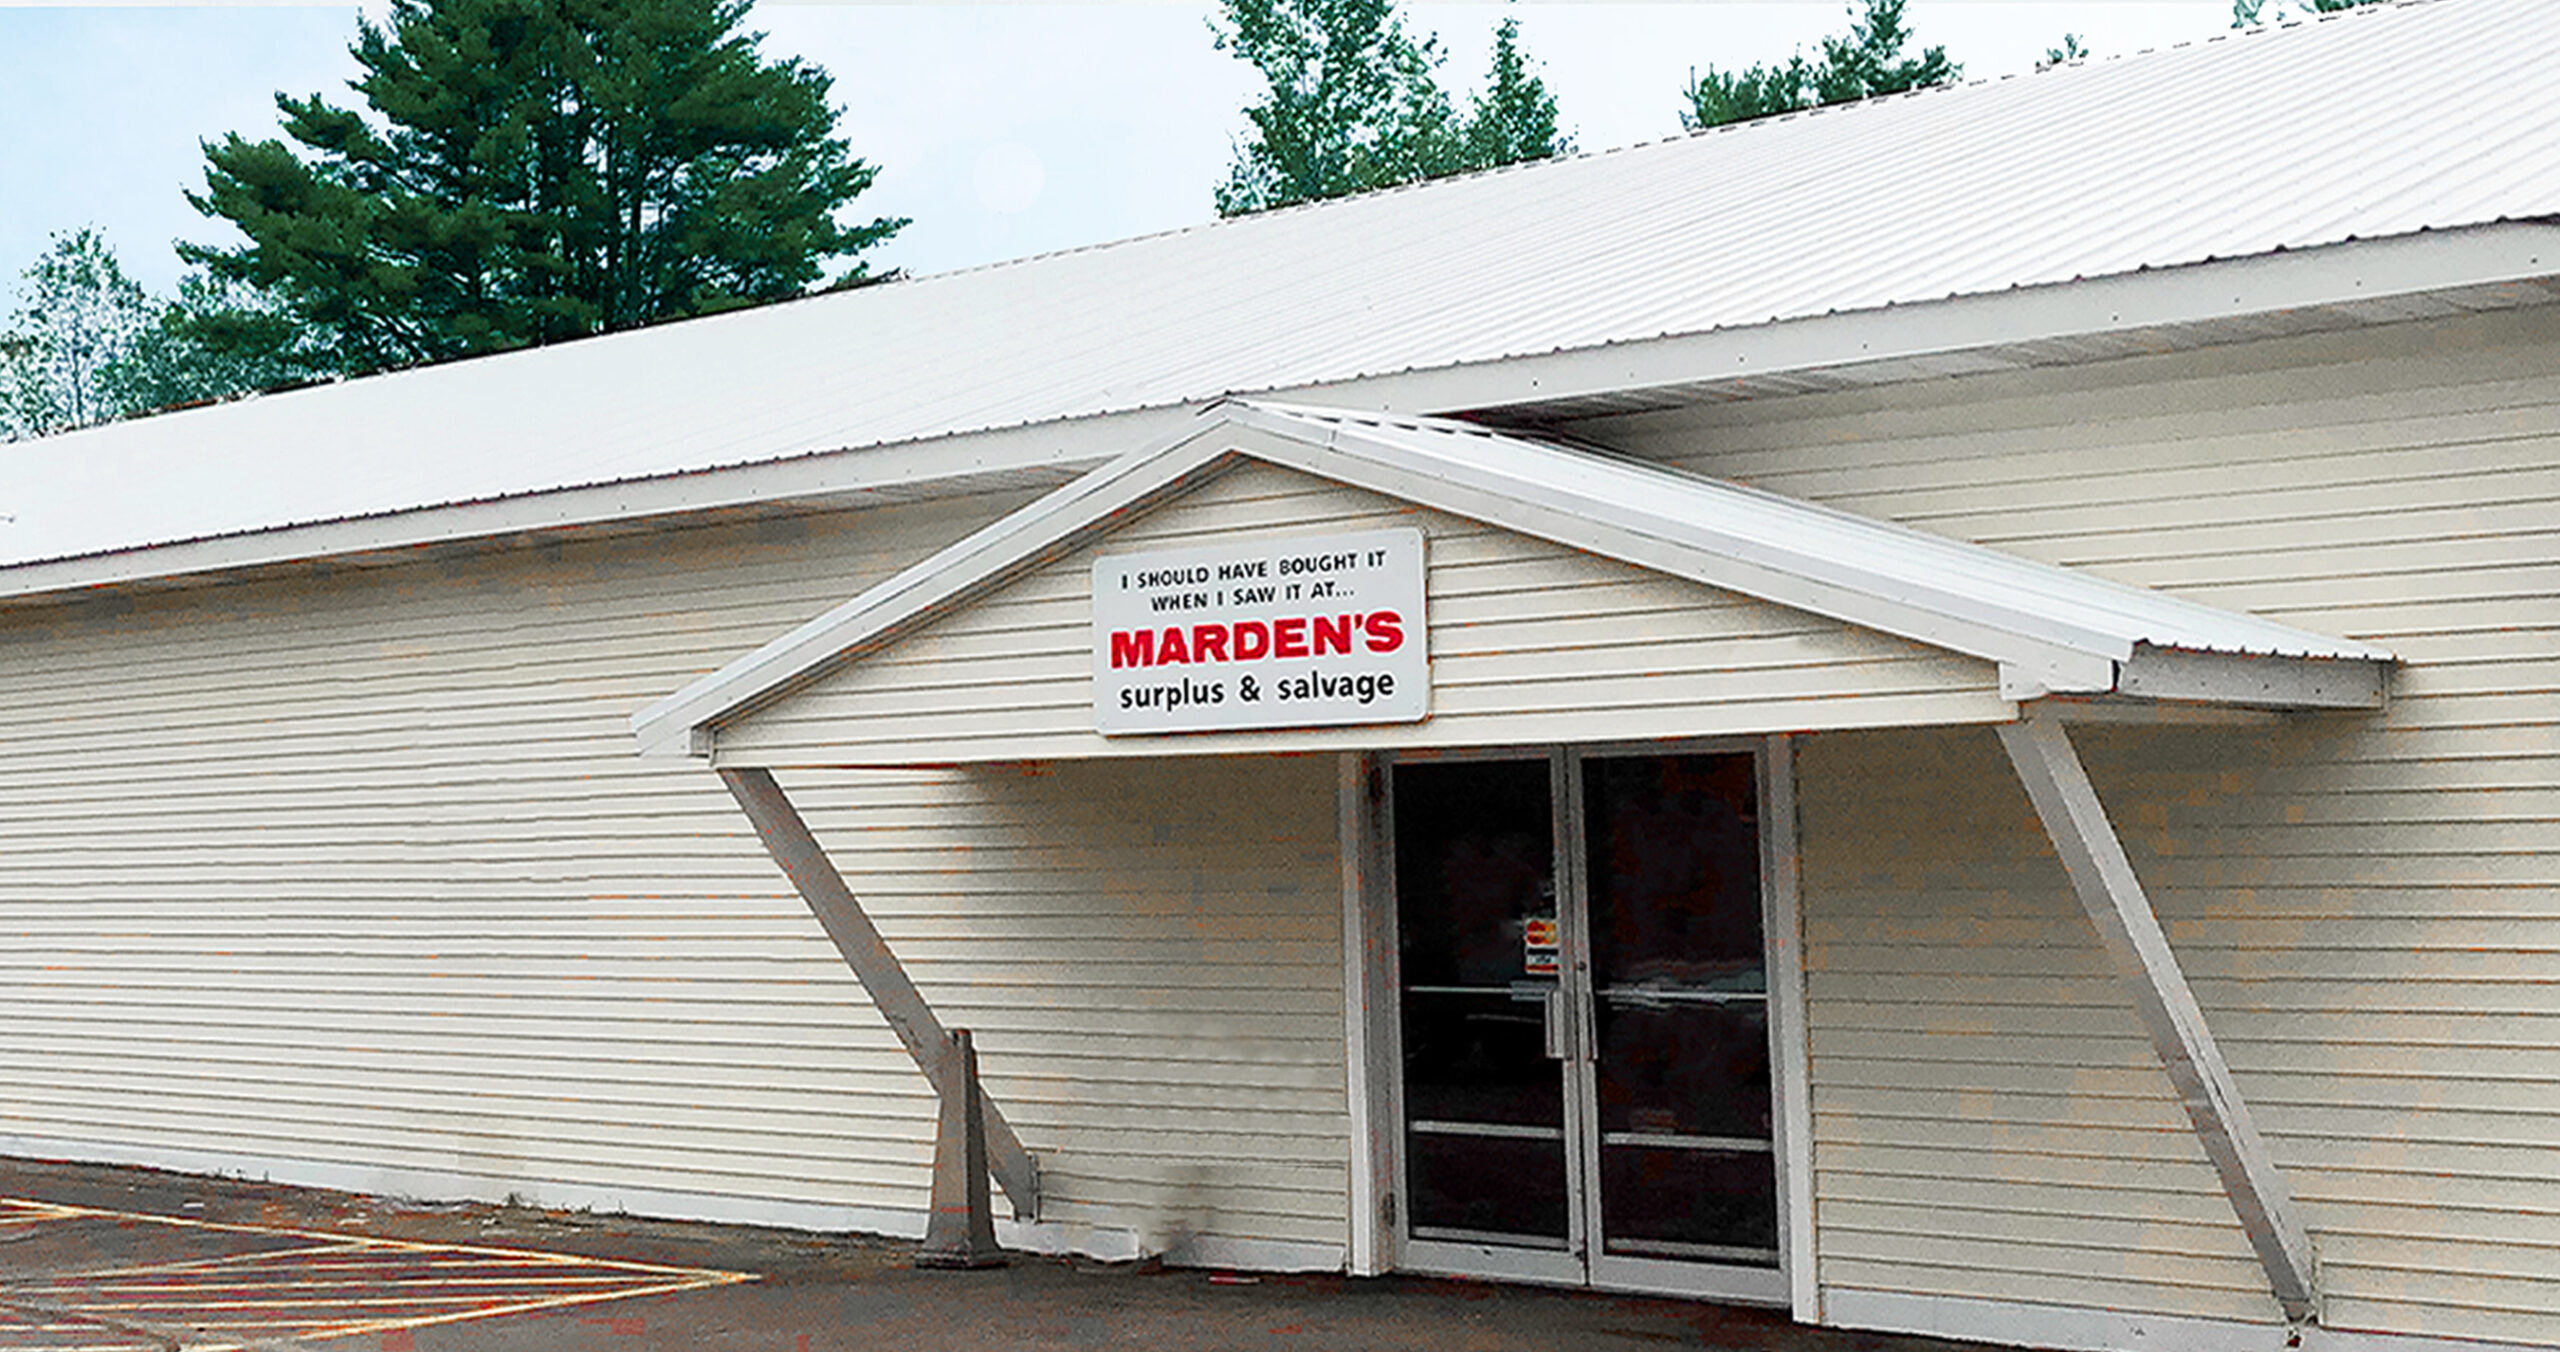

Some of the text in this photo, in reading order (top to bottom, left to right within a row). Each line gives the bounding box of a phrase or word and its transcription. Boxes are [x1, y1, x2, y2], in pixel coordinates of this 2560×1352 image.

[1121, 550, 1386, 590] I SHOULD HAVE BOUGHT IT
[1151, 581, 1354, 612] WHEN I SAW IT AT...
[1110, 610, 1405, 668] MARDEN'S
[1120, 670, 1395, 713] surplus & salvage
